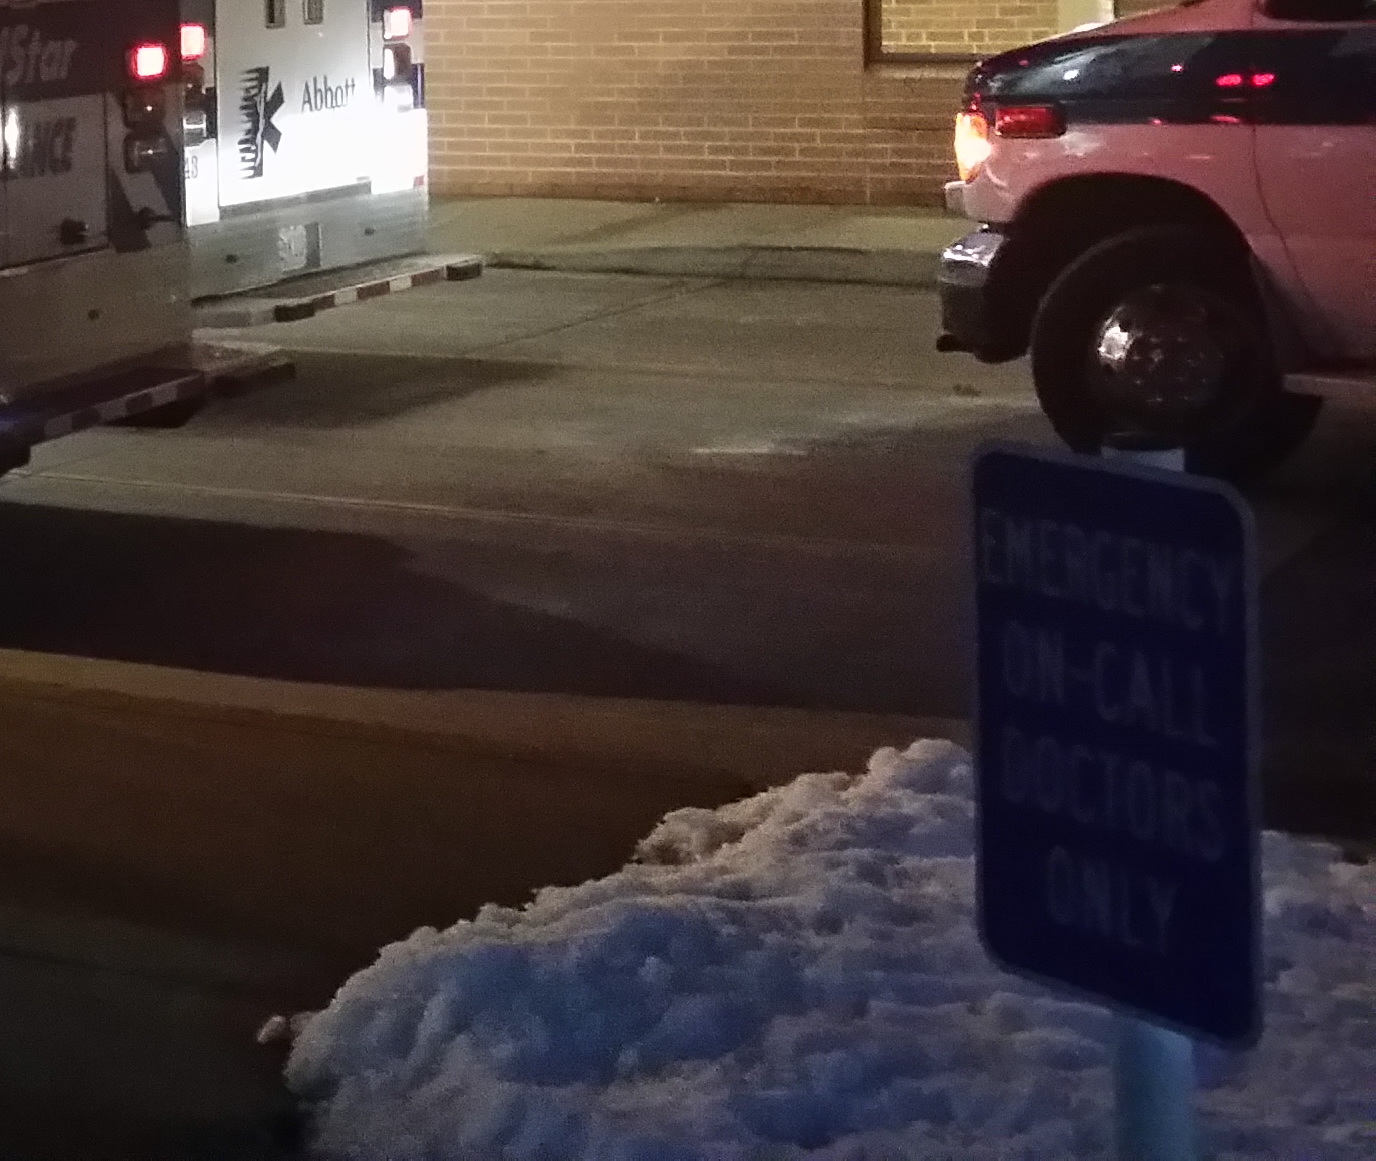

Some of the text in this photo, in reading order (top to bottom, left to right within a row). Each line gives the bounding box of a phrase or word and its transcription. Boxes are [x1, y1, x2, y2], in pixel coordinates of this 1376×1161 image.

[980, 505, 1236, 634] EMERGENCY
[1000, 619, 1218, 749] ON-CALL
[999, 723, 1226, 864] DOCTORS
[1046, 844, 1180, 956] ONLY
